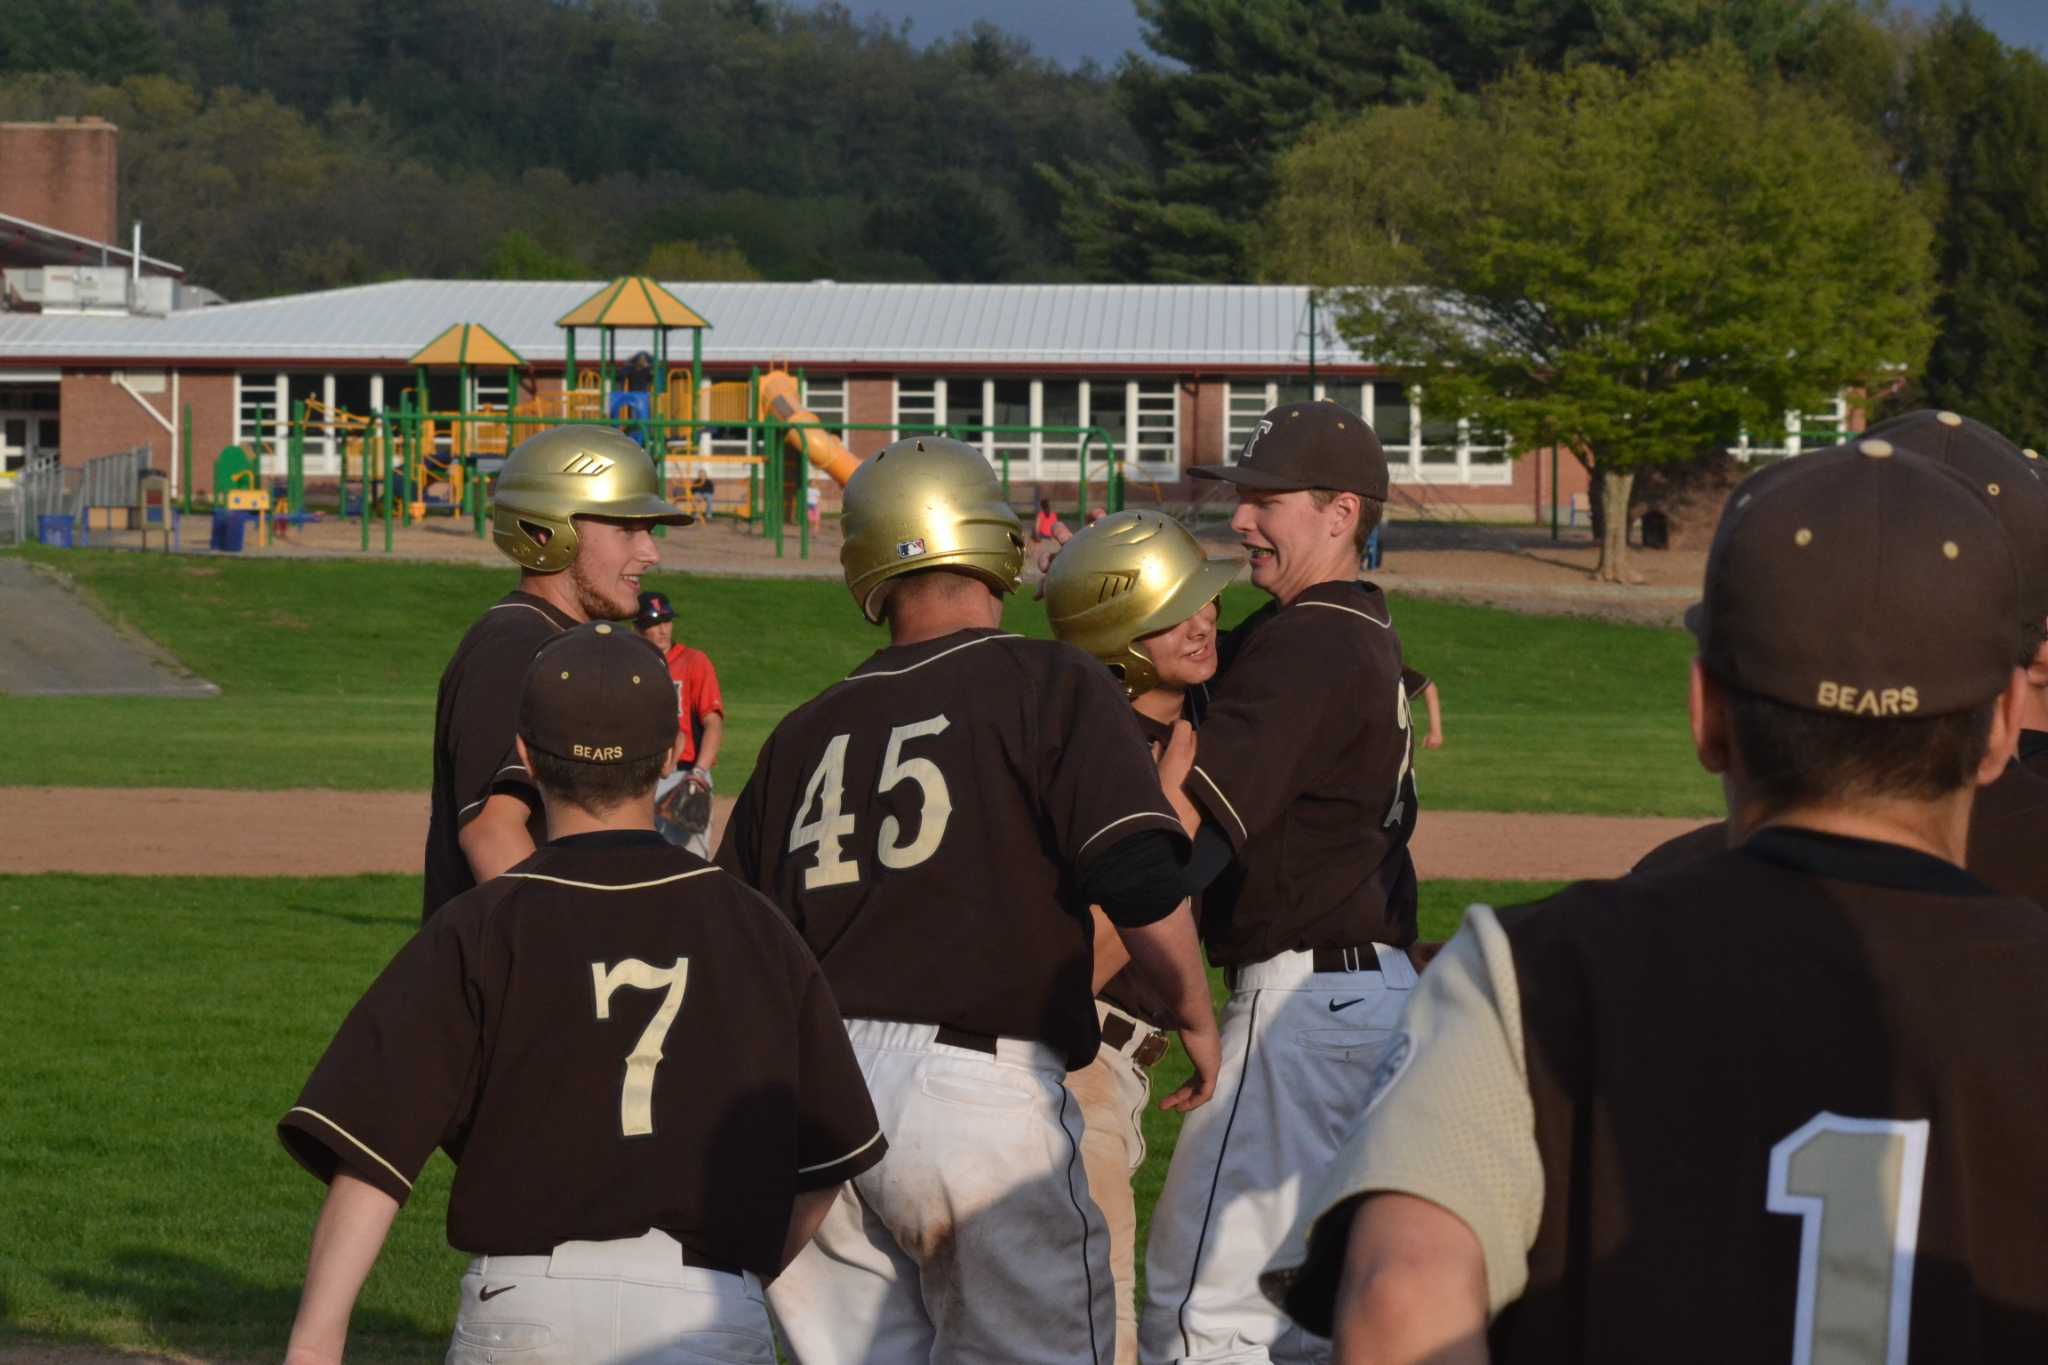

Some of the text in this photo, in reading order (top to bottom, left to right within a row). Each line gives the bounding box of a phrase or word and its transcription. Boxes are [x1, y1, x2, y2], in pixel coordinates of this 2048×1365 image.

[573, 744, 624, 761] BEARS
[1817, 681, 1920, 716] BEARS
[788, 713, 952, 890] 45
[591, 957, 689, 1137] 7
[1766, 1110, 1930, 1365] 1
